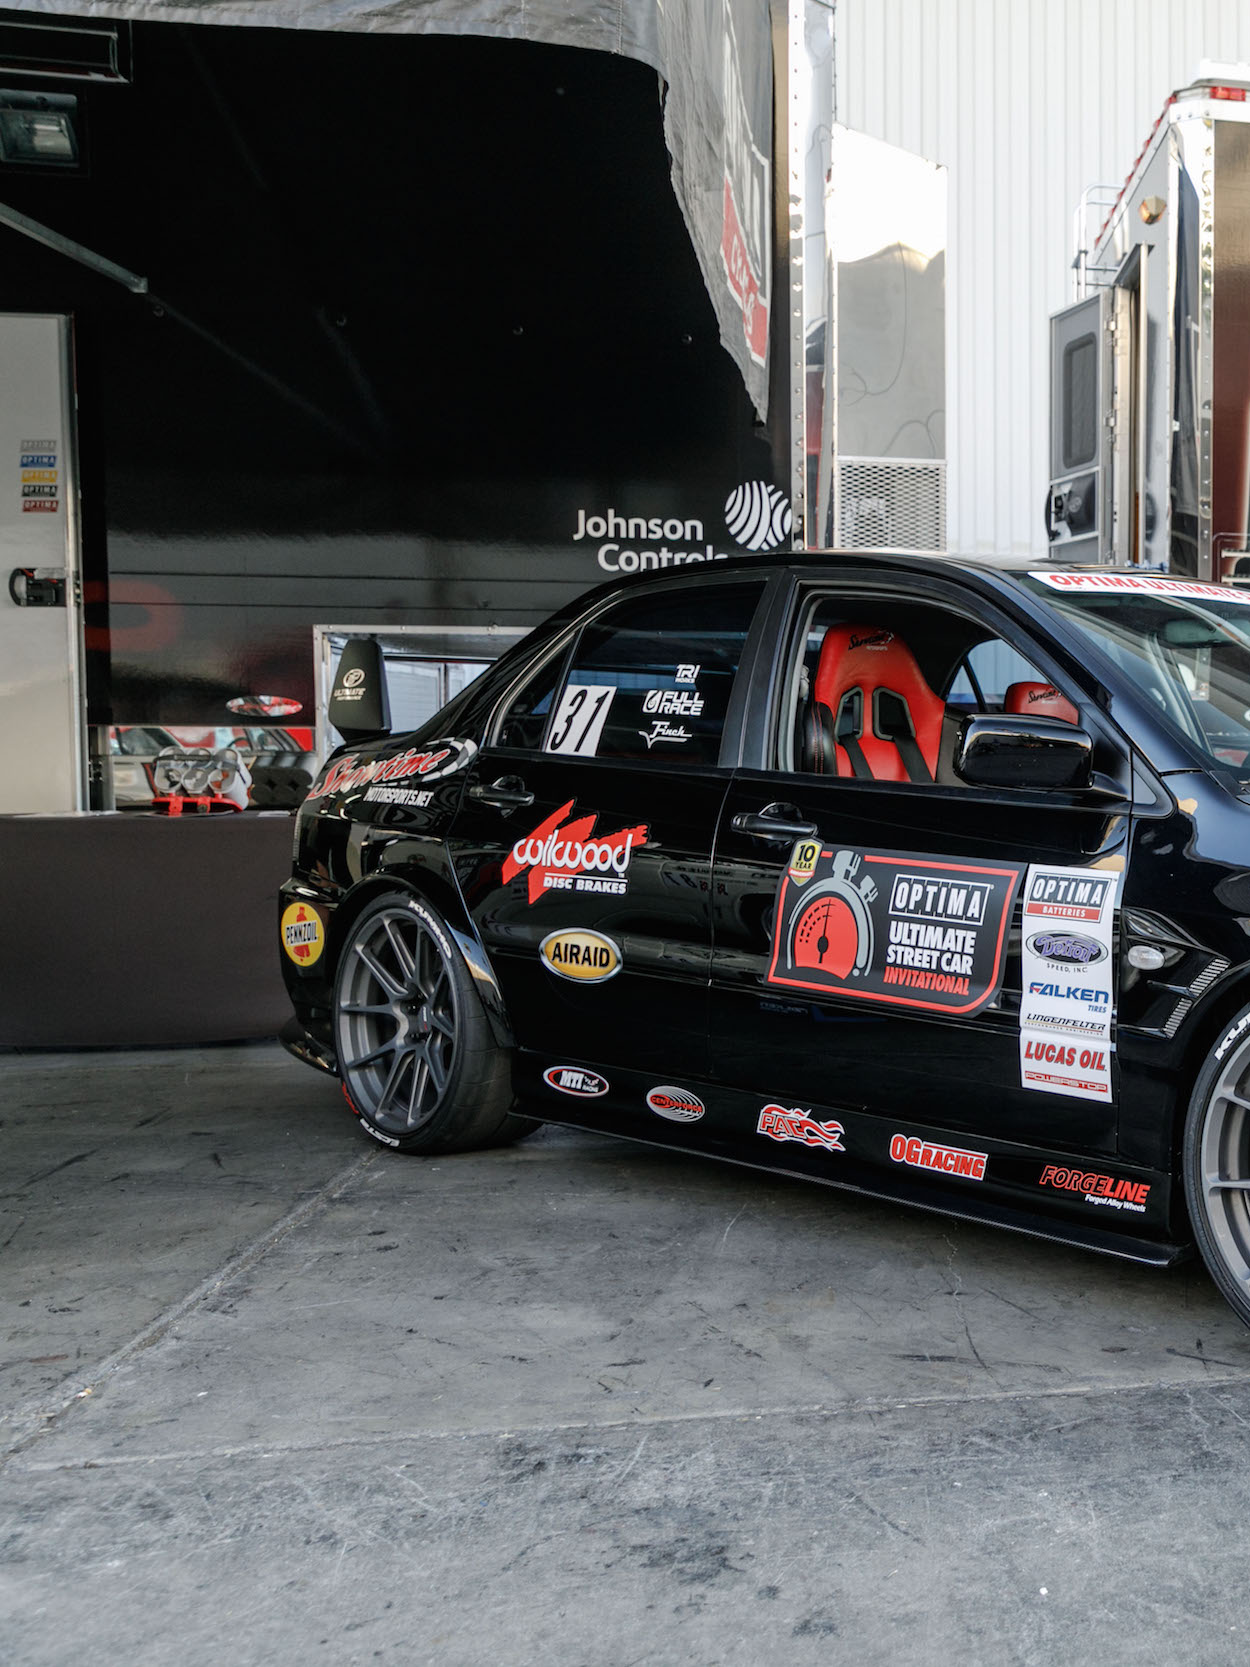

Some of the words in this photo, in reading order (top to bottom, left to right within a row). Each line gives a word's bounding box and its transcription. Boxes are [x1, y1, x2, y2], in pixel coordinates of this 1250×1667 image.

[573, 508, 703, 541] Johnson
[1049, 575, 1145, 588] OPTIMA
[1143, 580, 1238, 598] ULTIMATE
[676, 664, 700, 678] TRI
[663, 691, 704, 704] FULL
[658, 701, 704, 716] RACE
[551, 689, 610, 752] 31
[651, 721, 692, 738] Finch
[306, 748, 451, 799] Showtime
[363, 786, 434, 807] MOTORSPORTS.NET
[513, 829, 633, 873] wilwood
[798, 844, 816, 862] 10
[795, 861, 812, 869] YEAR
[543, 877, 572, 890] DISC
[576, 879, 626, 895] BRAKES
[1032, 878, 1104, 905] OPTIMA
[895, 882, 980, 918] OPTIMA
[1042, 906, 1086, 918] BATTERIES
[285, 921, 319, 944] PENNZOIL
[889, 921, 977, 954] ULTIMATE
[551, 942, 610, 968] AIRAID
[886, 944, 941, 972] STREET
[940, 953, 974, 975] CAR
[1036, 936, 1098, 963] Detroit
[1047, 963, 1071, 972] SPEED,
[883, 966, 970, 996] INVITATIONAL
[1029, 982, 1109, 1003] FALKEN
[1087, 1005, 1107, 1014] TIRES
[1027, 1013, 1106, 1030] LINGENFELTER
[1024, 1041, 1077, 1066] LUCAS
[1080, 1050, 1106, 1071] OIL
[559, 1070, 584, 1089] MTI
[1025, 1072, 1108, 1092] POWERSTOP
[650, 1096, 702, 1112] CENTERFORCE
[759, 1113, 808, 1139] PAC
[1039, 1166, 1151, 1204] FORGELINE
[1085, 1194, 1107, 1205] Forged
[1107, 1198, 1123, 1209] Alloy
[1123, 1201, 1146, 1213] Wheels
